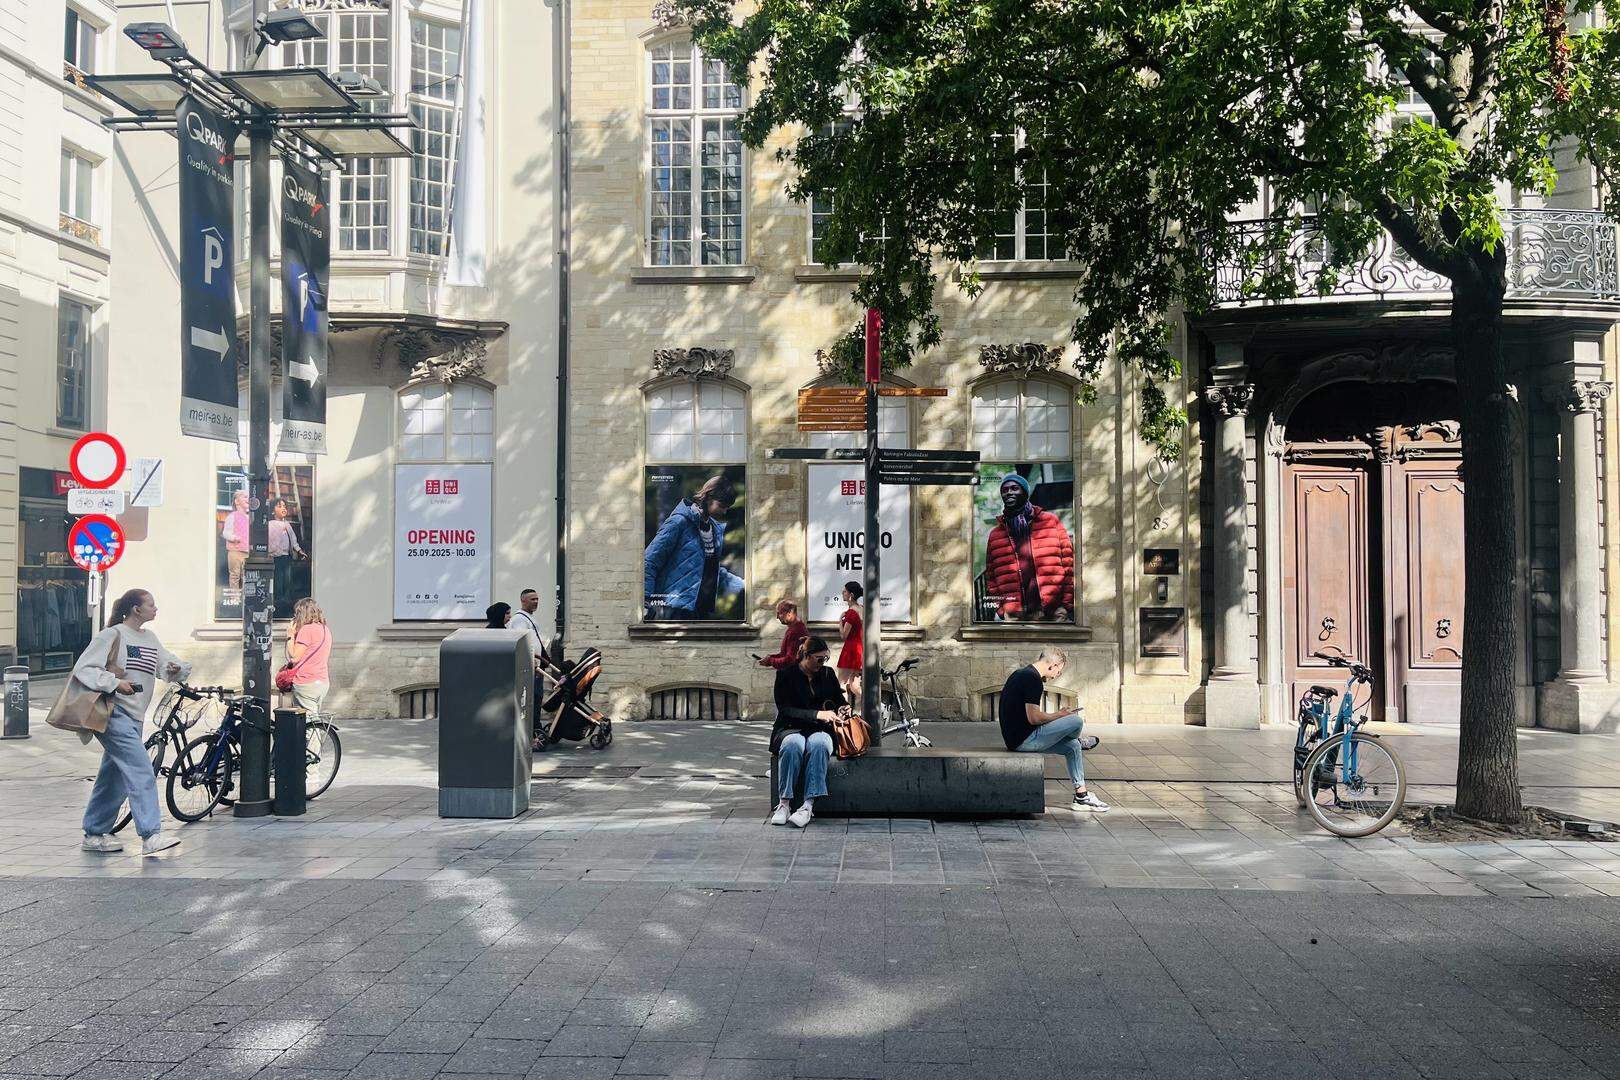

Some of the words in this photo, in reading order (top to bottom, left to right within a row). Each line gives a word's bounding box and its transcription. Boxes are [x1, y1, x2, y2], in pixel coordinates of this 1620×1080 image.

[187, 154, 211, 176] Quality
[204, 234, 224, 285] P
[189, 408, 233, 427] meir-as.be
[1153, 517, 1169, 530] 85
[407, 529, 475, 544] OPENING
[824, 531, 893, 550] UNIQO
[407, 548, 451, 557] 25.09.2025
[456, 548, 476, 557] 10:00
[836, 553, 863, 571] ME
